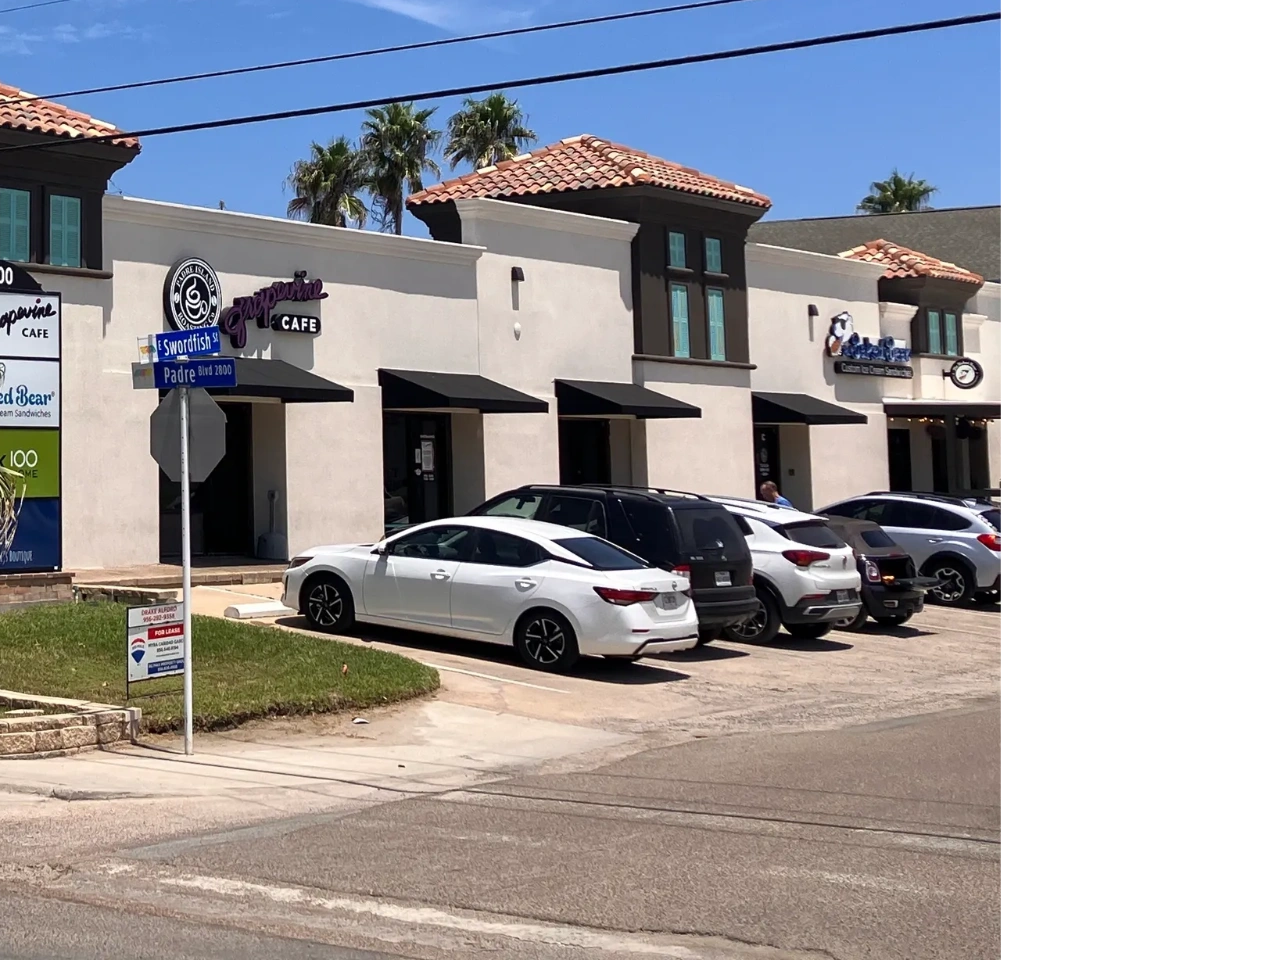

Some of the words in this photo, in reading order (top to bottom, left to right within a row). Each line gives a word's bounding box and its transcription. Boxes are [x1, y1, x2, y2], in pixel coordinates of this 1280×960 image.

[175, 265, 194, 288] PADRE
[195, 266, 215, 291] ISLAND
[22, 328, 49, 339] CAFE
[281, 316, 317, 332] CAFE
[158, 340, 162, 351] E
[163, 332, 211, 357] Swordfish
[212, 332, 219, 343] St
[164, 366, 196, 383] Padre
[198, 365, 213, 376] Blvd
[214, 364, 232, 376] 2800
[16, 384, 52, 407] Bear
[14, 409, 52, 418] Sandwiches
[10, 449, 38, 468] 100
[165, 627, 181, 635] LEASE
